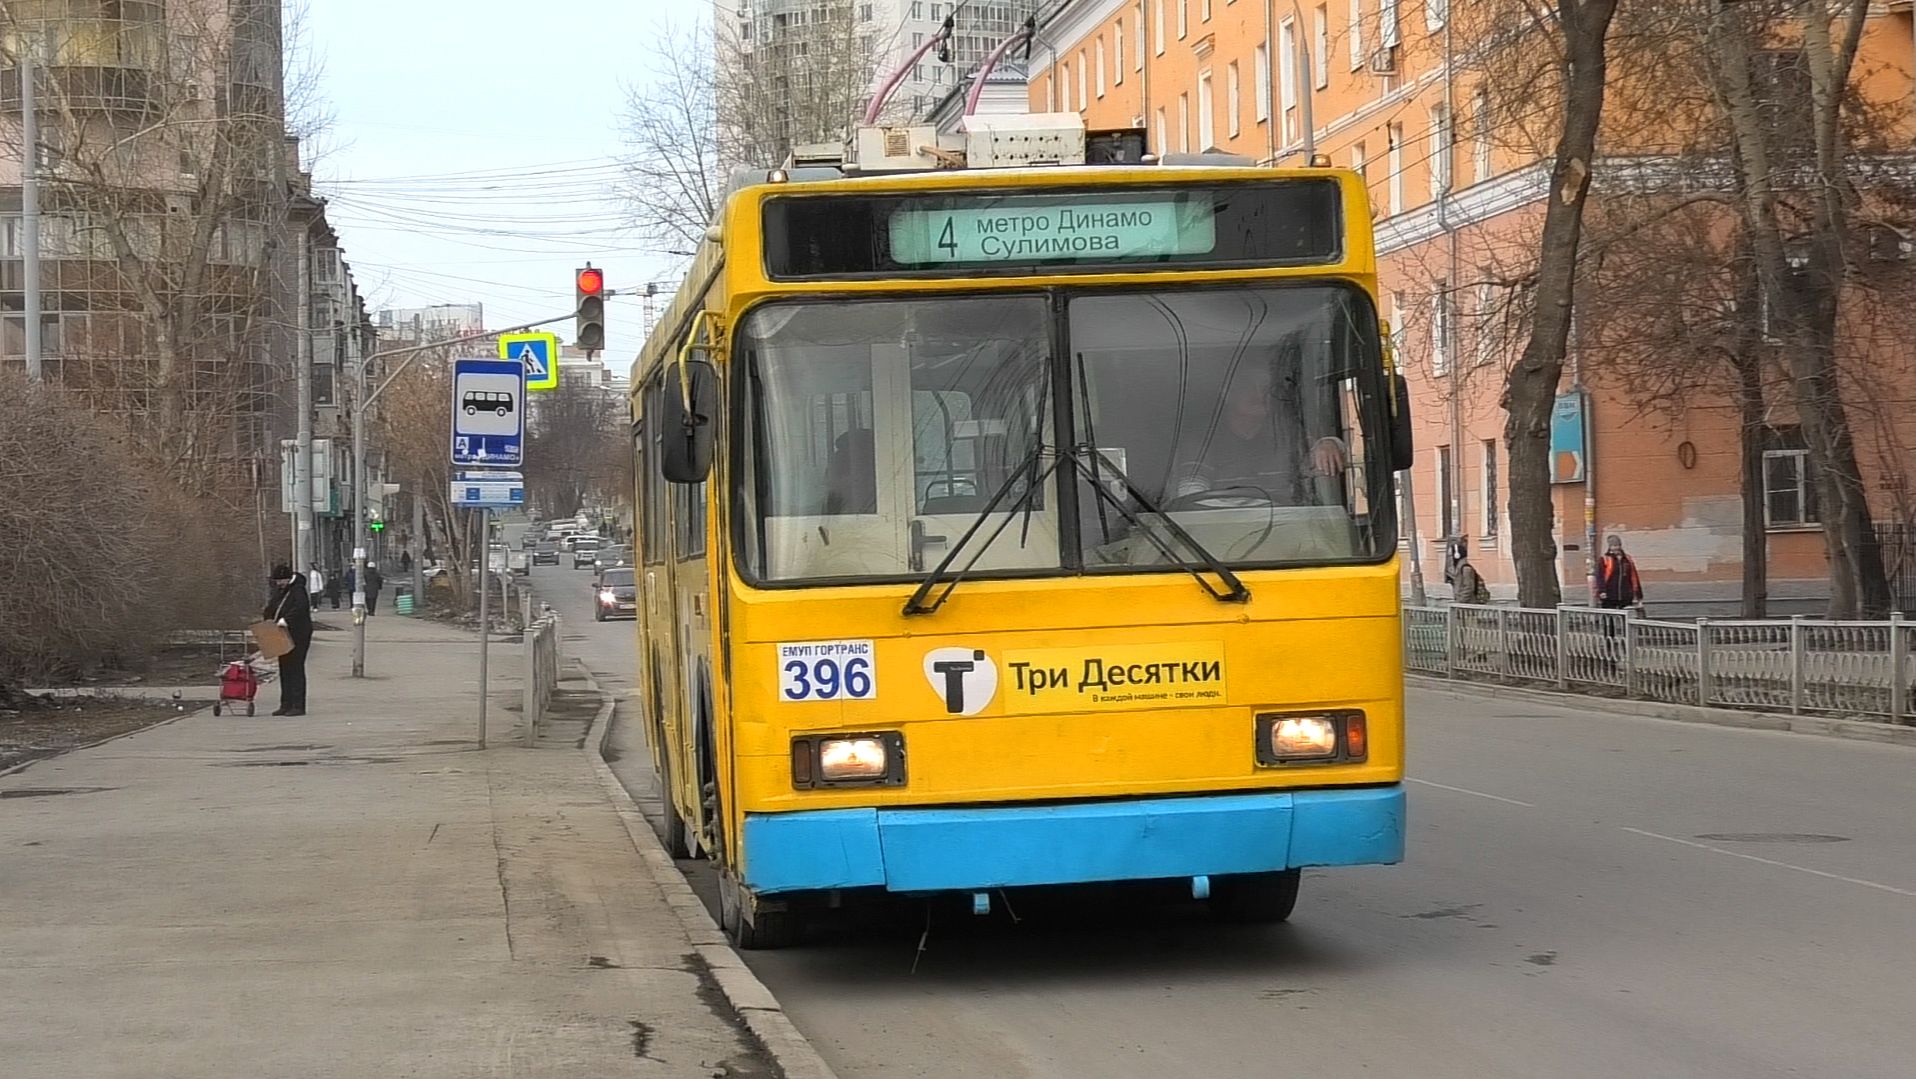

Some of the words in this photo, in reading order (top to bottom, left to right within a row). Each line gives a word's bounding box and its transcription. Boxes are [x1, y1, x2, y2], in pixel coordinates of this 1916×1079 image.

[977, 215, 1050, 236] метро
[1058, 209, 1153, 232] Динамо
[938, 216, 958, 257] 4
[980, 234, 1120, 259] Сулимова
[782, 646, 812, 657] ЕМУП
[815, 643, 869, 657] ГОРТРАНС
[784, 657, 871, 700] 396
[1008, 662, 1069, 695] Три
[1078, 658, 1221, 693] Десятки
[1092, 694, 1099, 702] В
[1100, 693, 1133, 703] каждой
[1134, 693, 1169, 701] машине
